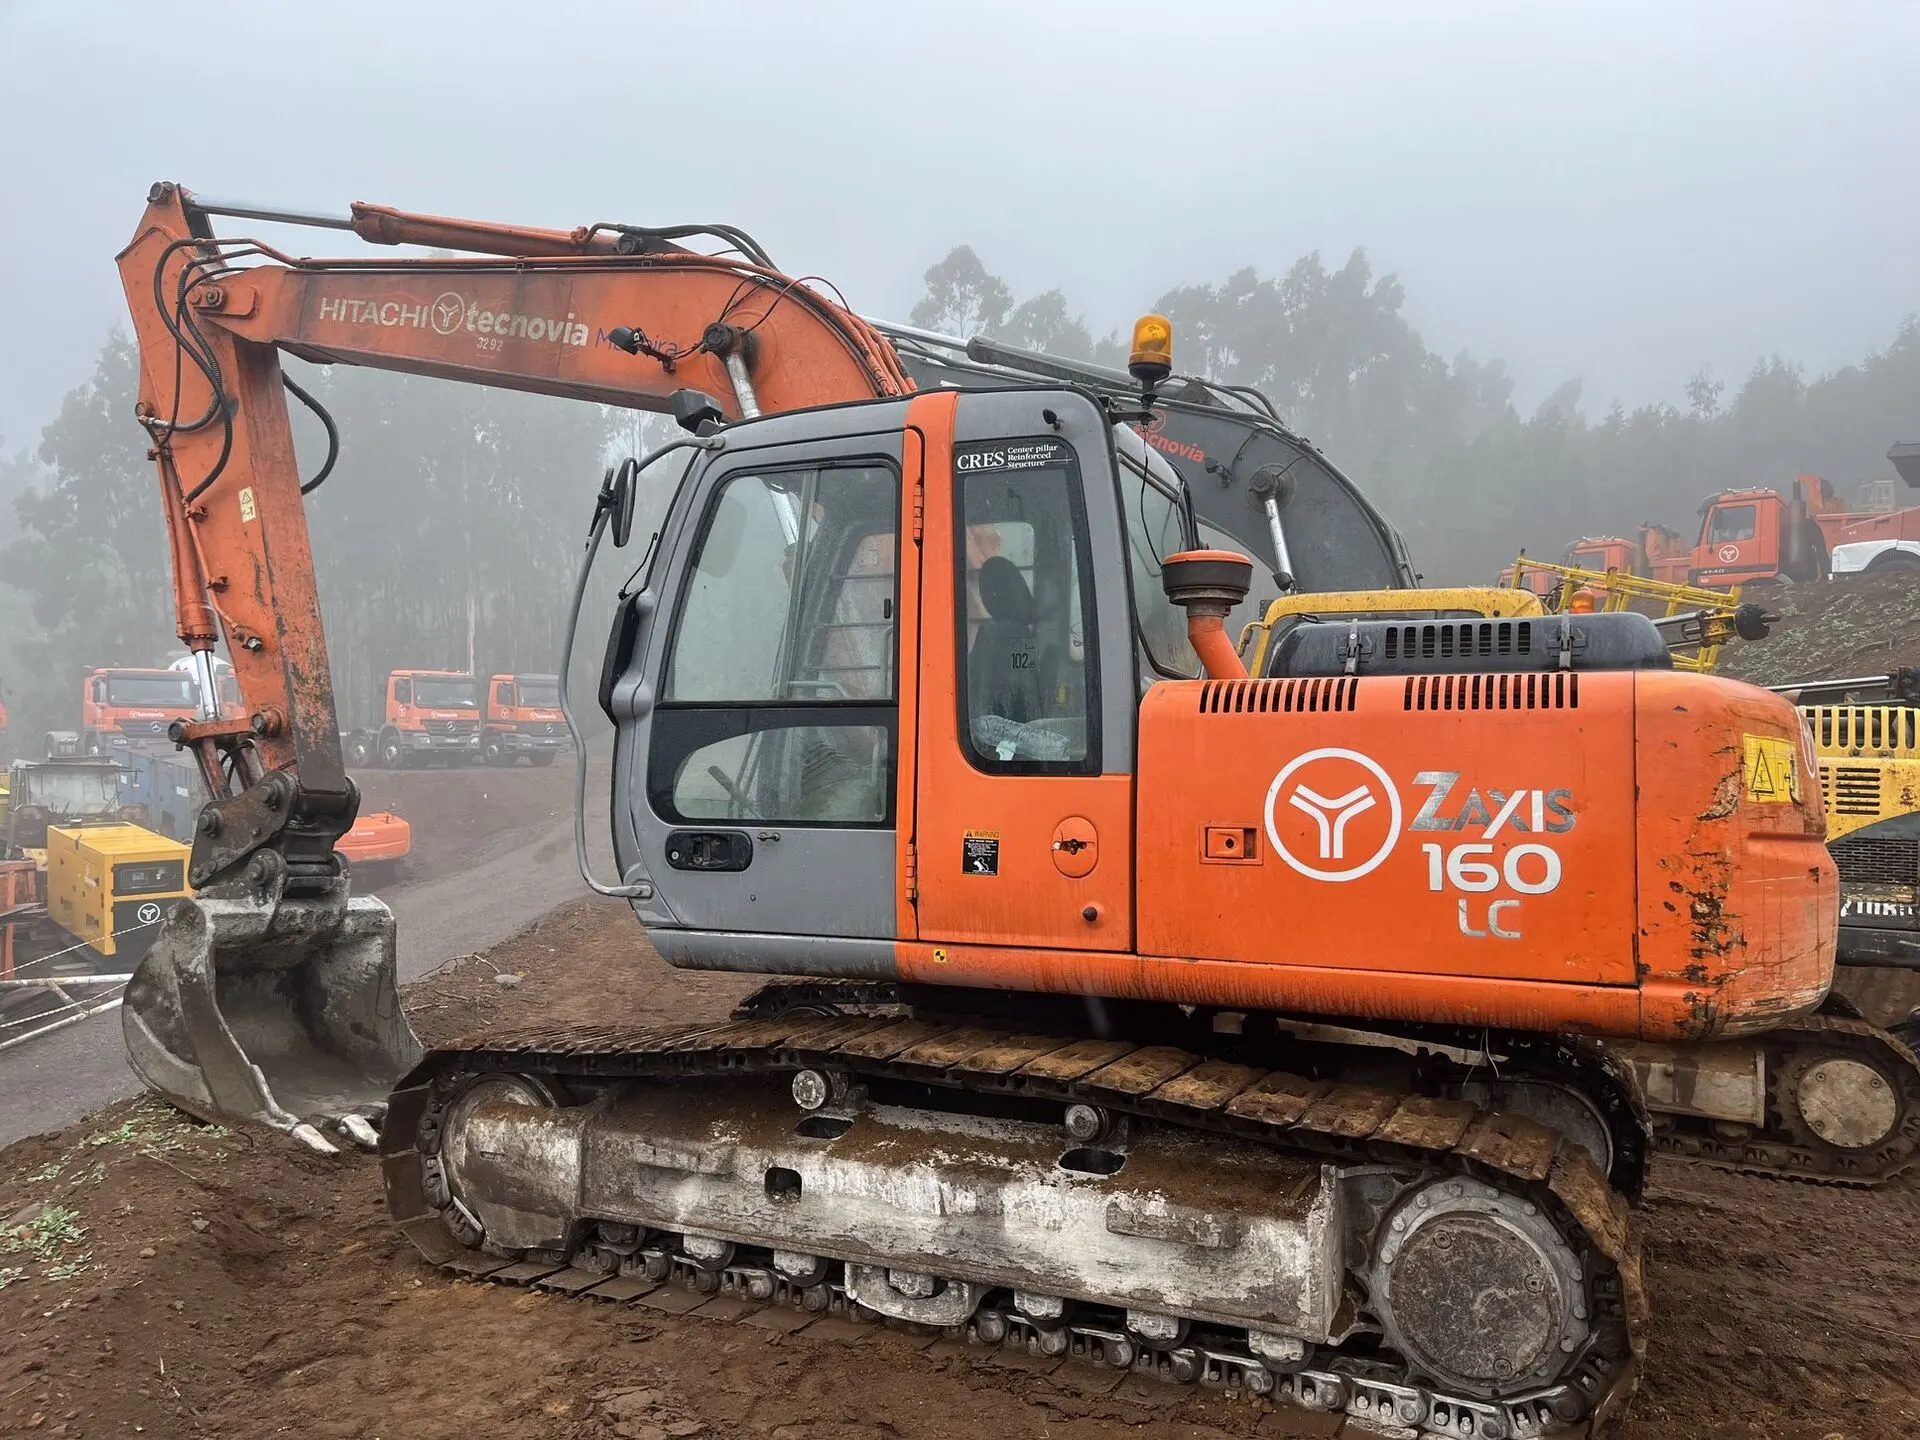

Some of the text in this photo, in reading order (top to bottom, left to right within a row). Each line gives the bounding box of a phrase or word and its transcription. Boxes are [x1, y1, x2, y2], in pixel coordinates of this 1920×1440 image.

[319, 297, 589, 347] HITACHI tecnovia
[476, 336, 504, 351] 3292
[1007, 444, 1059, 455] Center pillar
[1007, 451, 1052, 461] Reinforced
[957, 451, 1005, 470] CRES
[1007, 460, 1046, 469] Structure
[1011, 653, 1029, 669] 102
[1422, 843, 1562, 894] 160
[1458, 898, 1521, 939] LC
